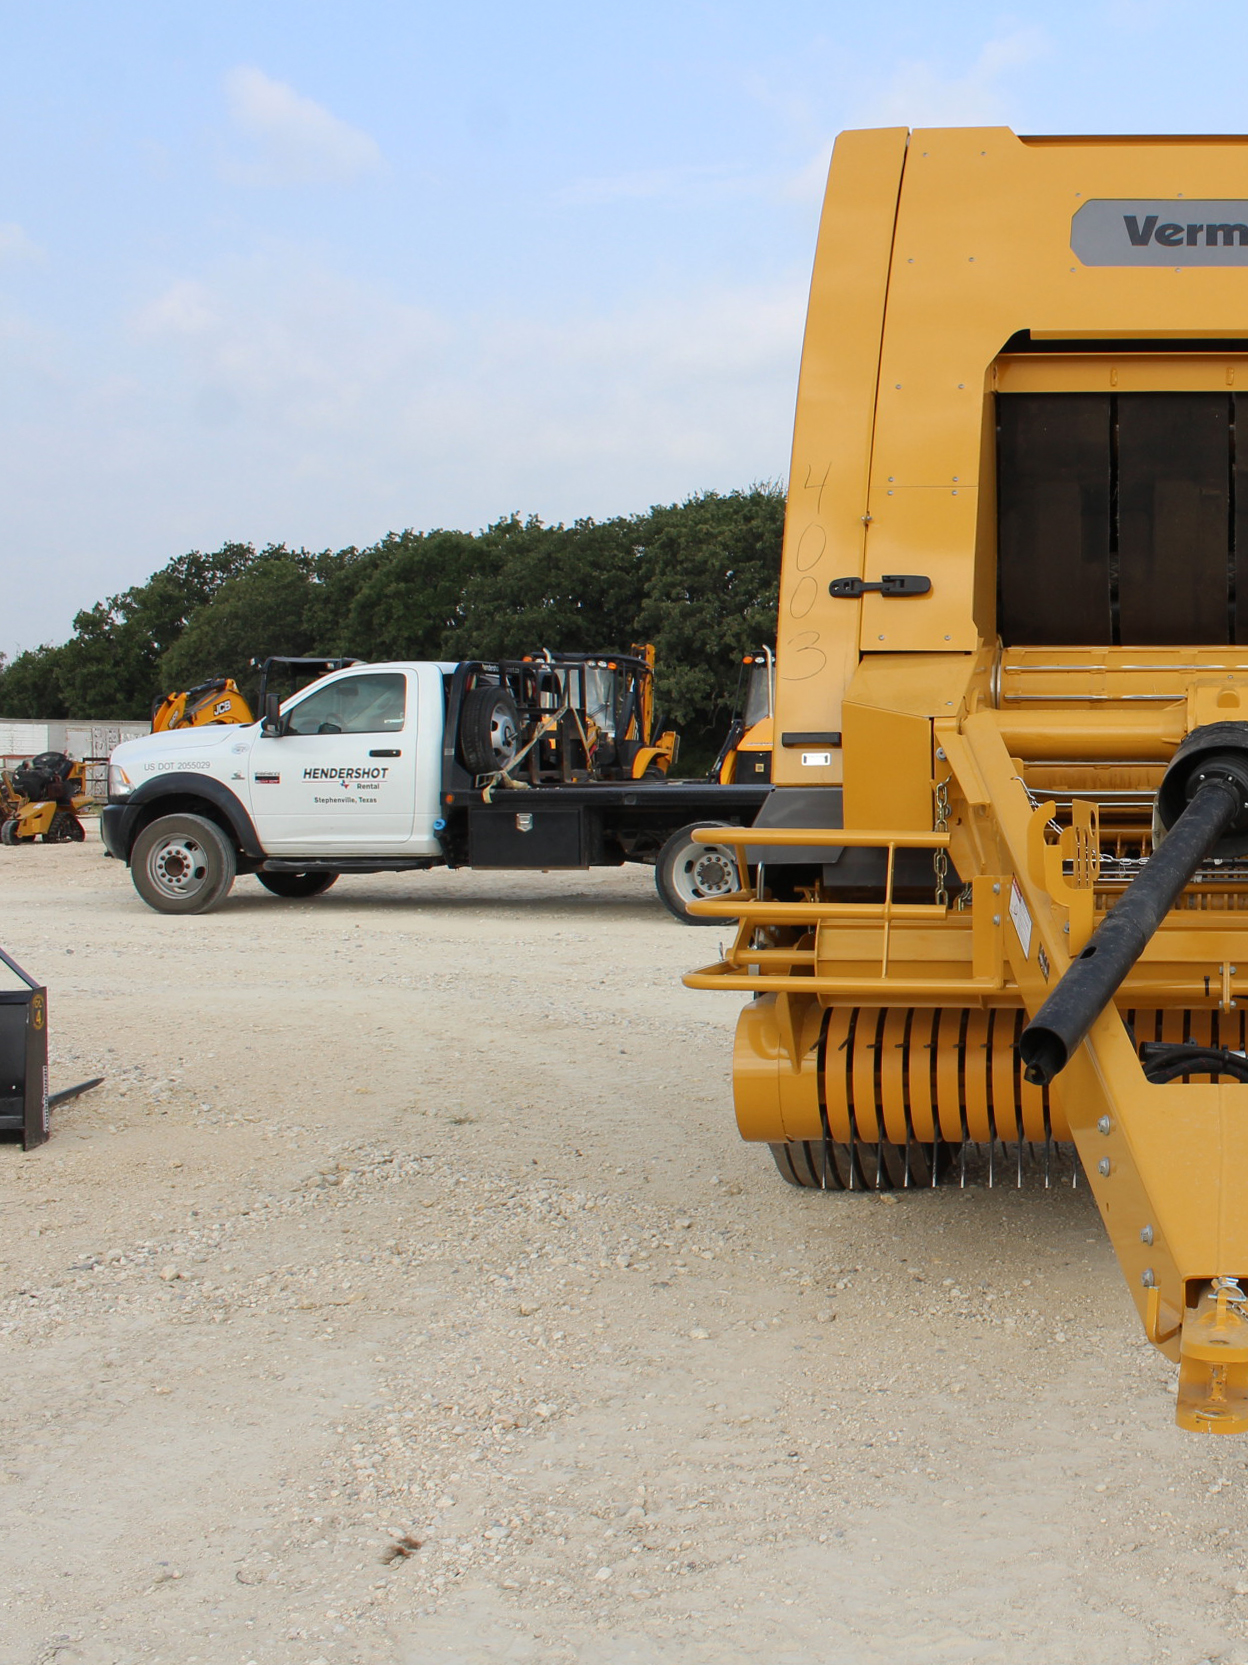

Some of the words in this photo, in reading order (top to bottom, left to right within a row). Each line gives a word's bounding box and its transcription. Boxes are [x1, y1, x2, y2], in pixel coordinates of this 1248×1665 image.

[213, 700, 232, 717] JCB
[144, 762, 155, 771] US
[158, 762, 175, 770] DOT
[177, 761, 211, 770] 2055029
[303, 767, 389, 779] HENDERSHOT
